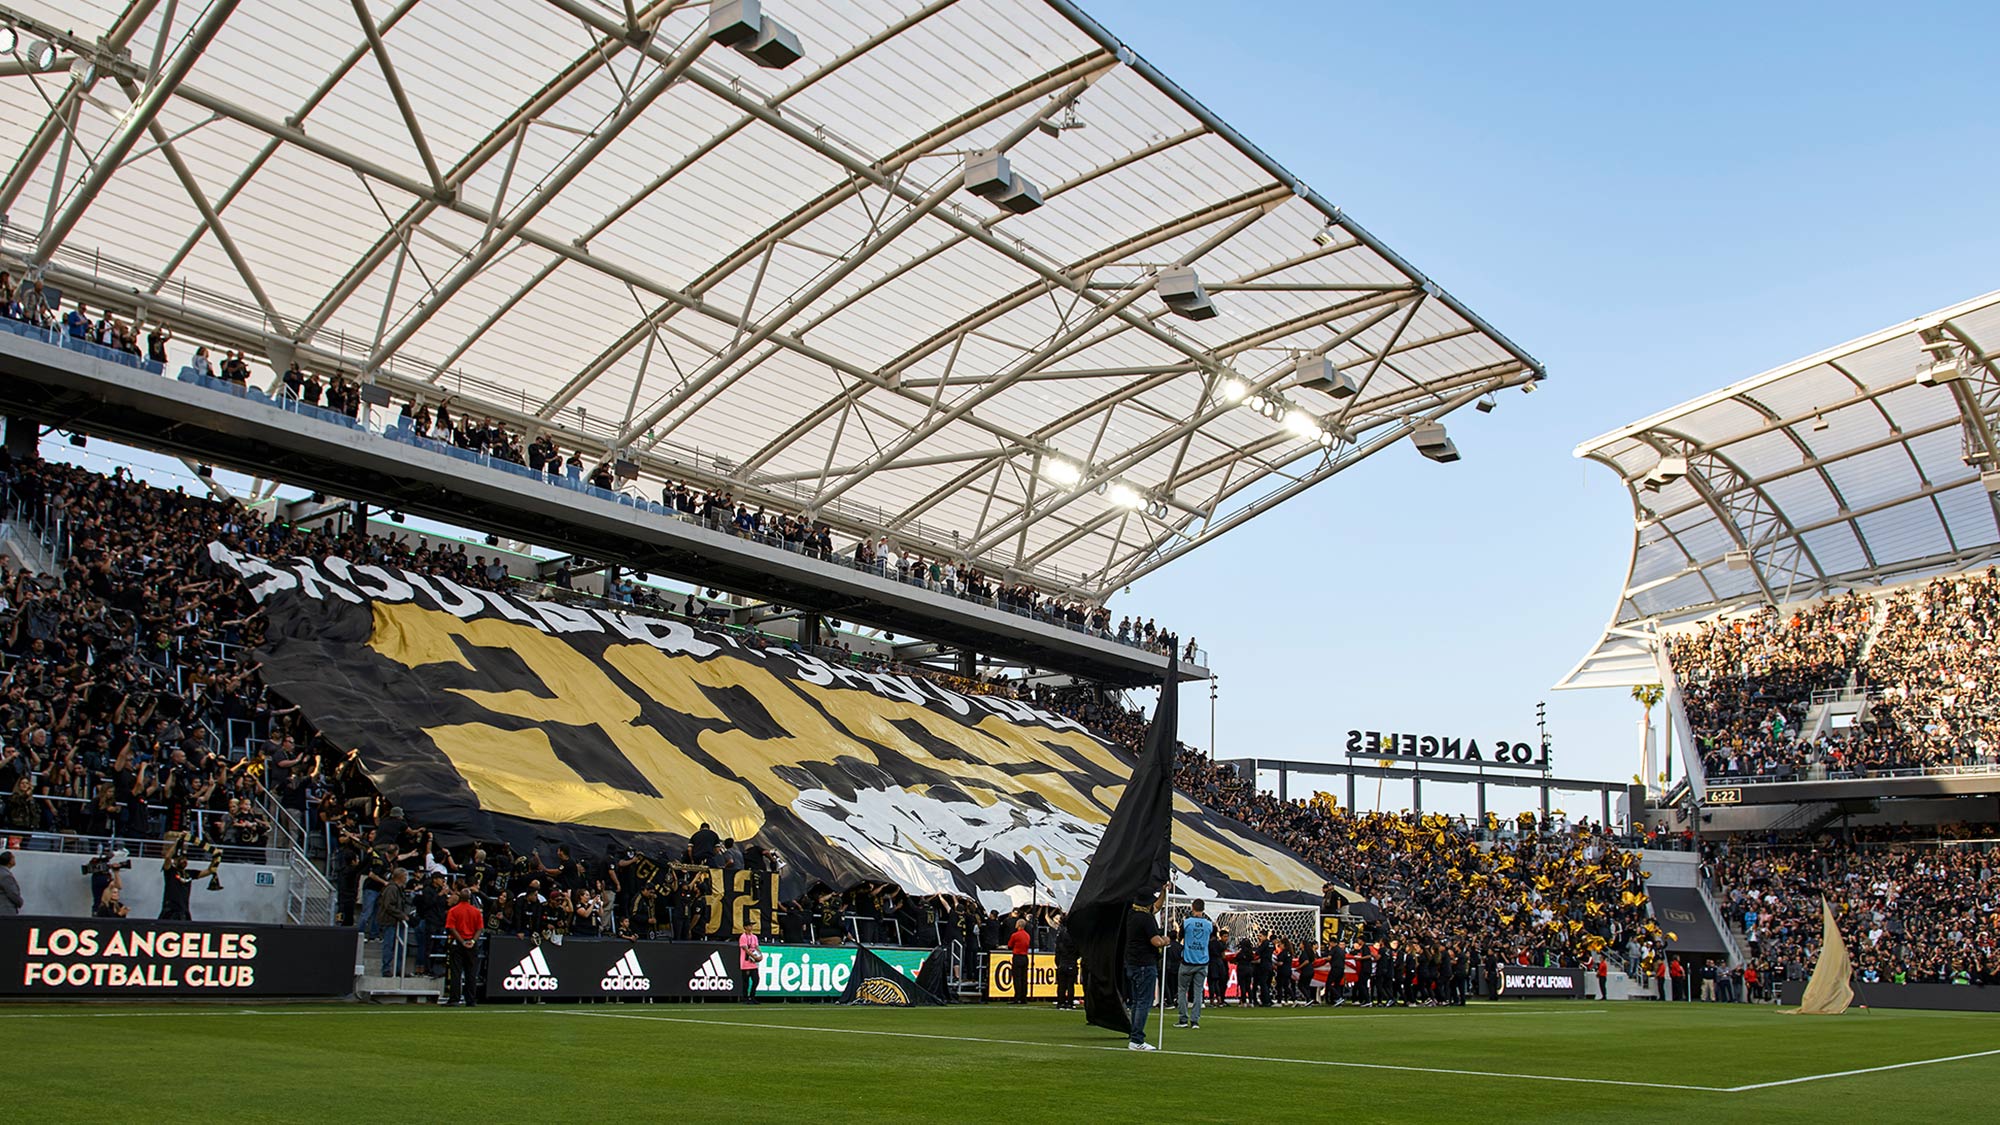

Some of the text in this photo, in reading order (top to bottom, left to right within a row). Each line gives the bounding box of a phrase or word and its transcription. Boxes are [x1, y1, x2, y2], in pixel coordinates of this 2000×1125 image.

[1711, 790, 1736, 802] 6:22
[1020, 844, 1082, 881] 23
[28, 928, 257, 960] LOS ANGELES
[24, 963, 254, 987] FOOTBALL CLUB
[757, 952, 904, 992] Heine
[503, 974, 558, 991] adidas
[600, 975, 650, 991] adidas
[689, 976, 733, 991] adidas
[1506, 975, 1573, 989] BANC OF CALIFORNIA
